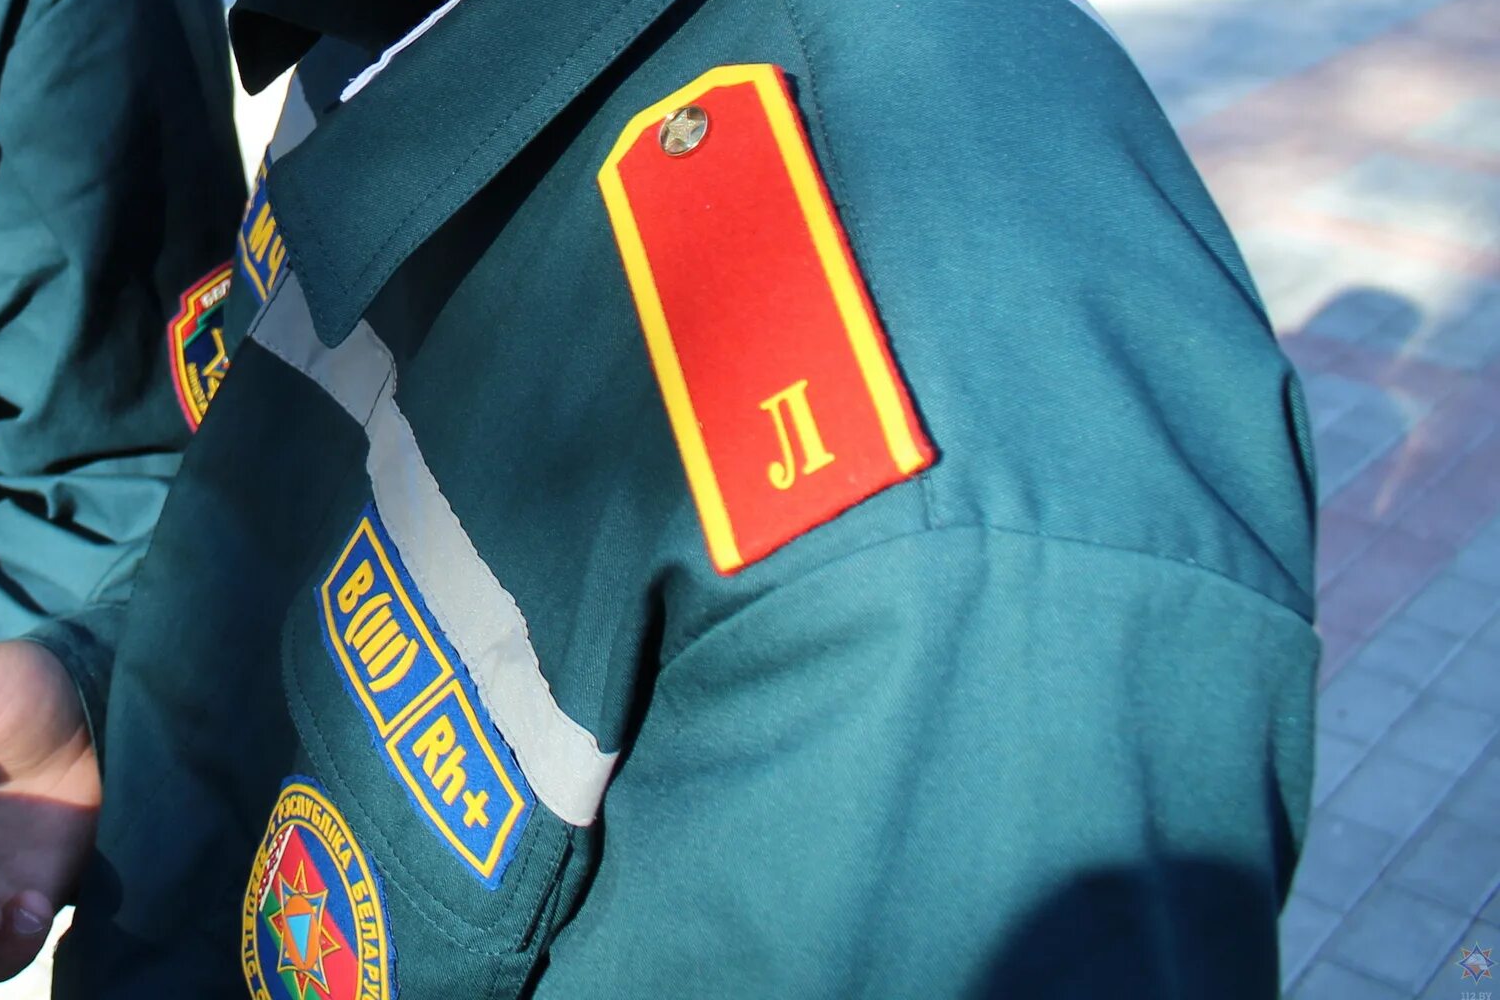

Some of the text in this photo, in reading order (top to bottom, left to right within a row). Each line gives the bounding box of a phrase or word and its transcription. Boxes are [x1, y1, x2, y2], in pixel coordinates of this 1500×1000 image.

[247, 202, 287, 291] МЧ
[758, 379, 836, 490] Л
[411, 713, 491, 829] Rh+
[277, 794, 354, 872] РЭСПУБЛІКА
